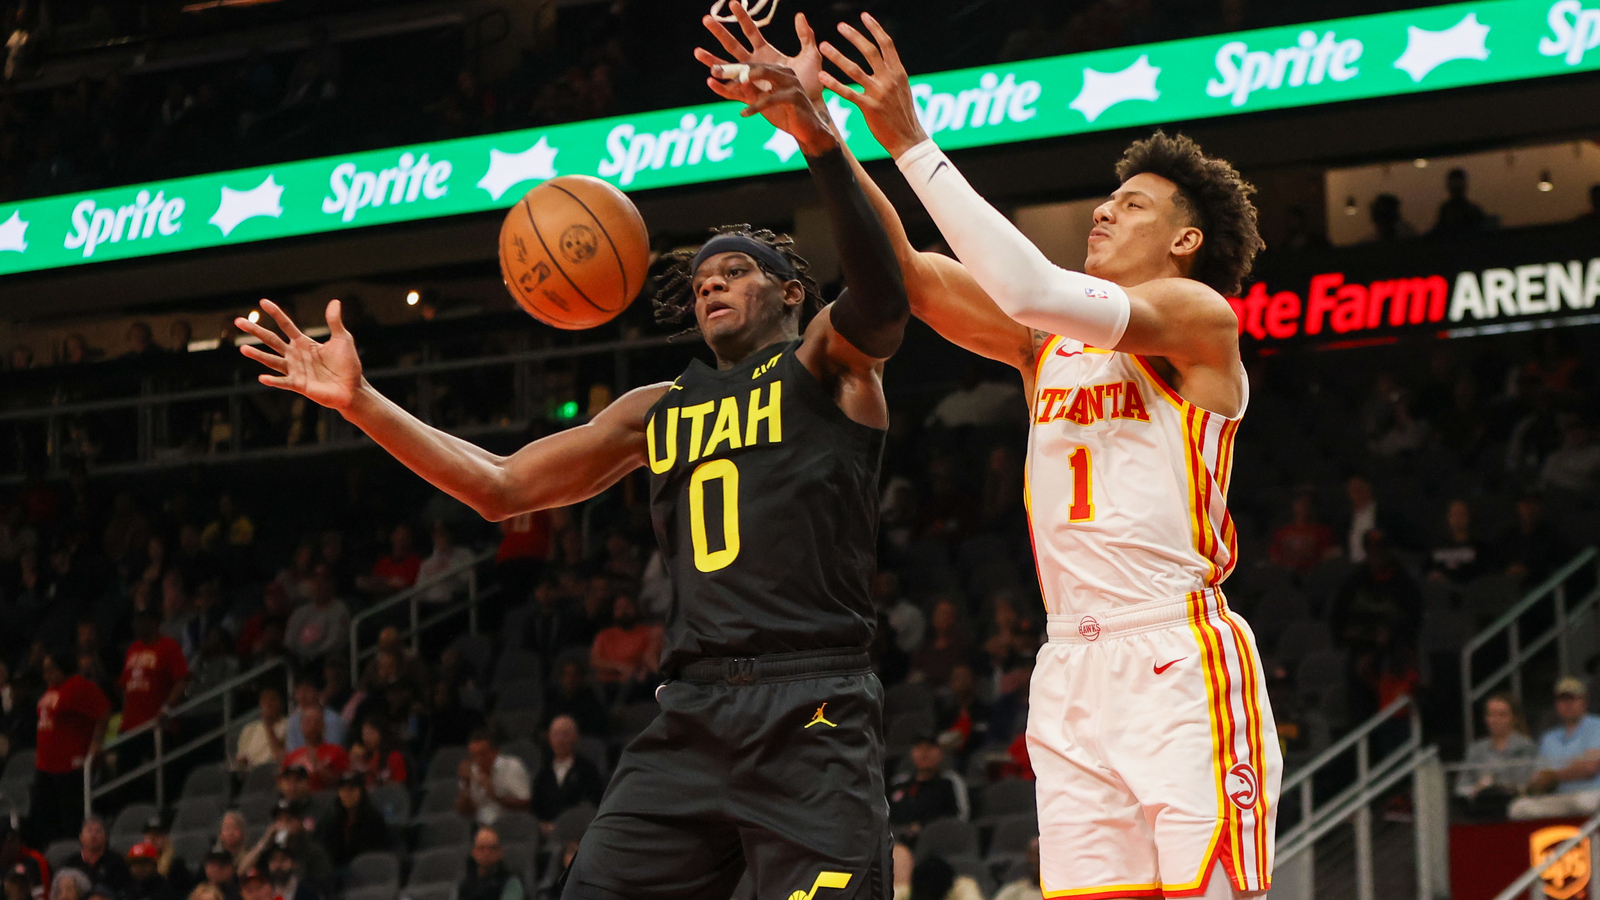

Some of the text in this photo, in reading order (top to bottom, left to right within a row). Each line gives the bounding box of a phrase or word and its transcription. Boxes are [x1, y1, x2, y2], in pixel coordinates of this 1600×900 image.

[63, 189, 185, 257] Sprite
[322, 152, 453, 222] Sprite
[598, 113, 738, 185] Sprite
[1206, 30, 1363, 106] Sprite
[1304, 272, 1449, 336] Farm
[646, 380, 782, 475] UTAH
[1033, 380, 1152, 426] TLANTA
[689, 458, 740, 573] 0
[1068, 445, 1095, 523] 1
[1078, 623, 1101, 635] HAWKS
